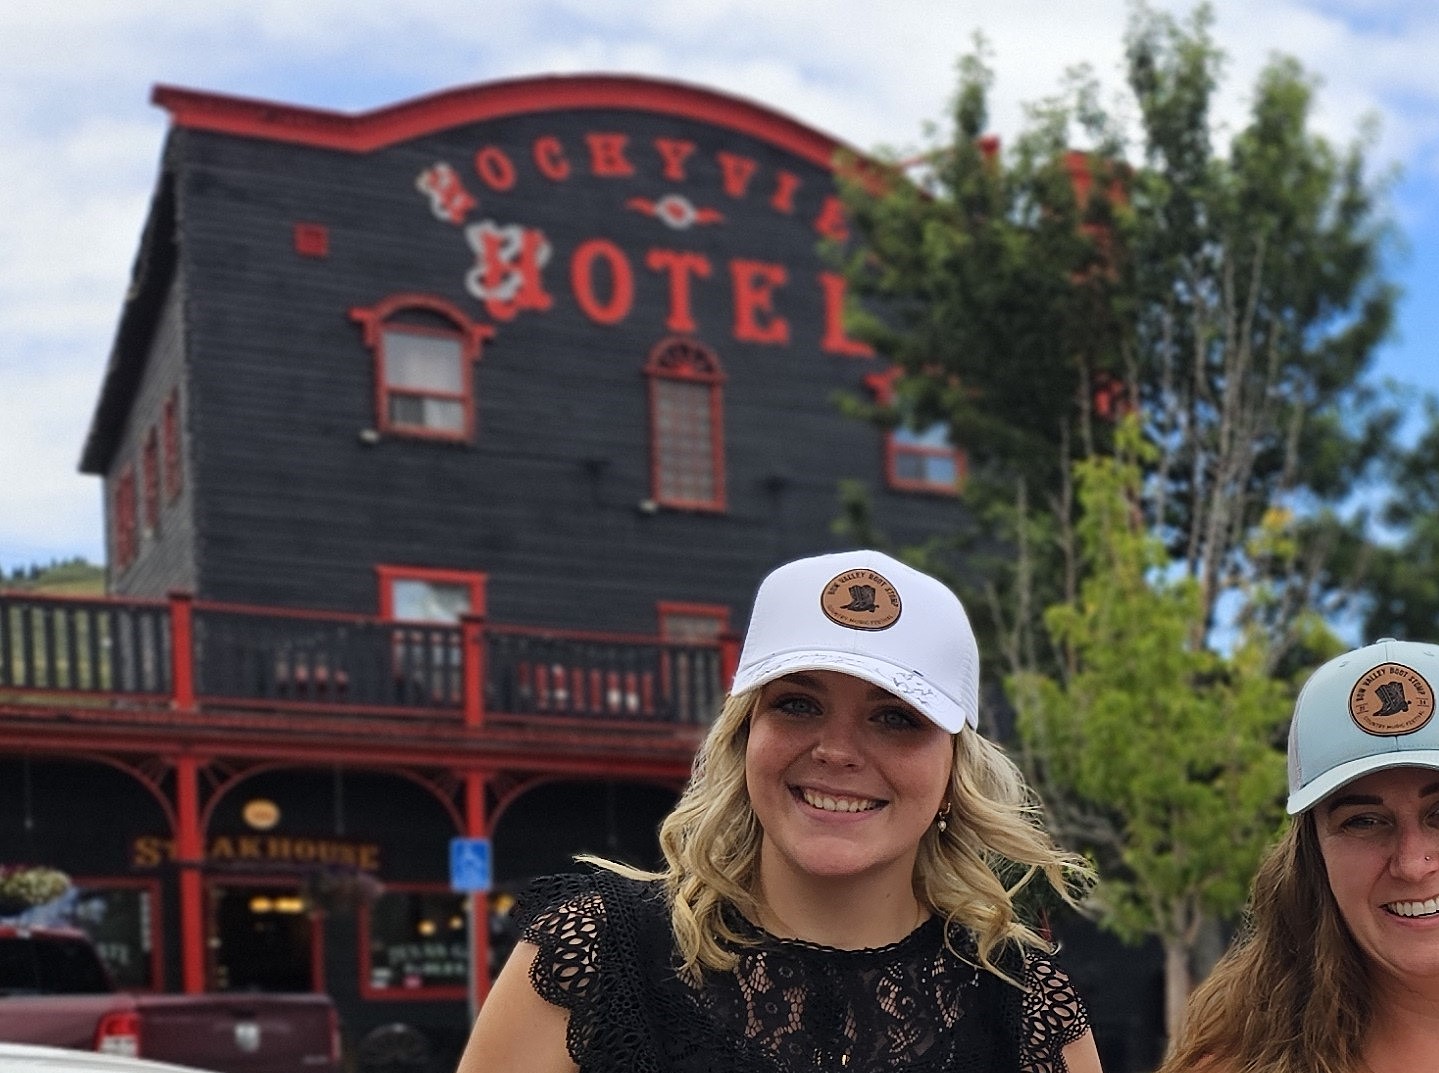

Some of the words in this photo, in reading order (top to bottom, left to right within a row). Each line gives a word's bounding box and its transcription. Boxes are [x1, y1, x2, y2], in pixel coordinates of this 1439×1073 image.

[417, 132, 850, 242] ROCKYVIE
[465, 222, 877, 358] HOTEL
[1363, 667, 1386, 686] VALLEY
[133, 836, 379, 870] STAKHOUSE
